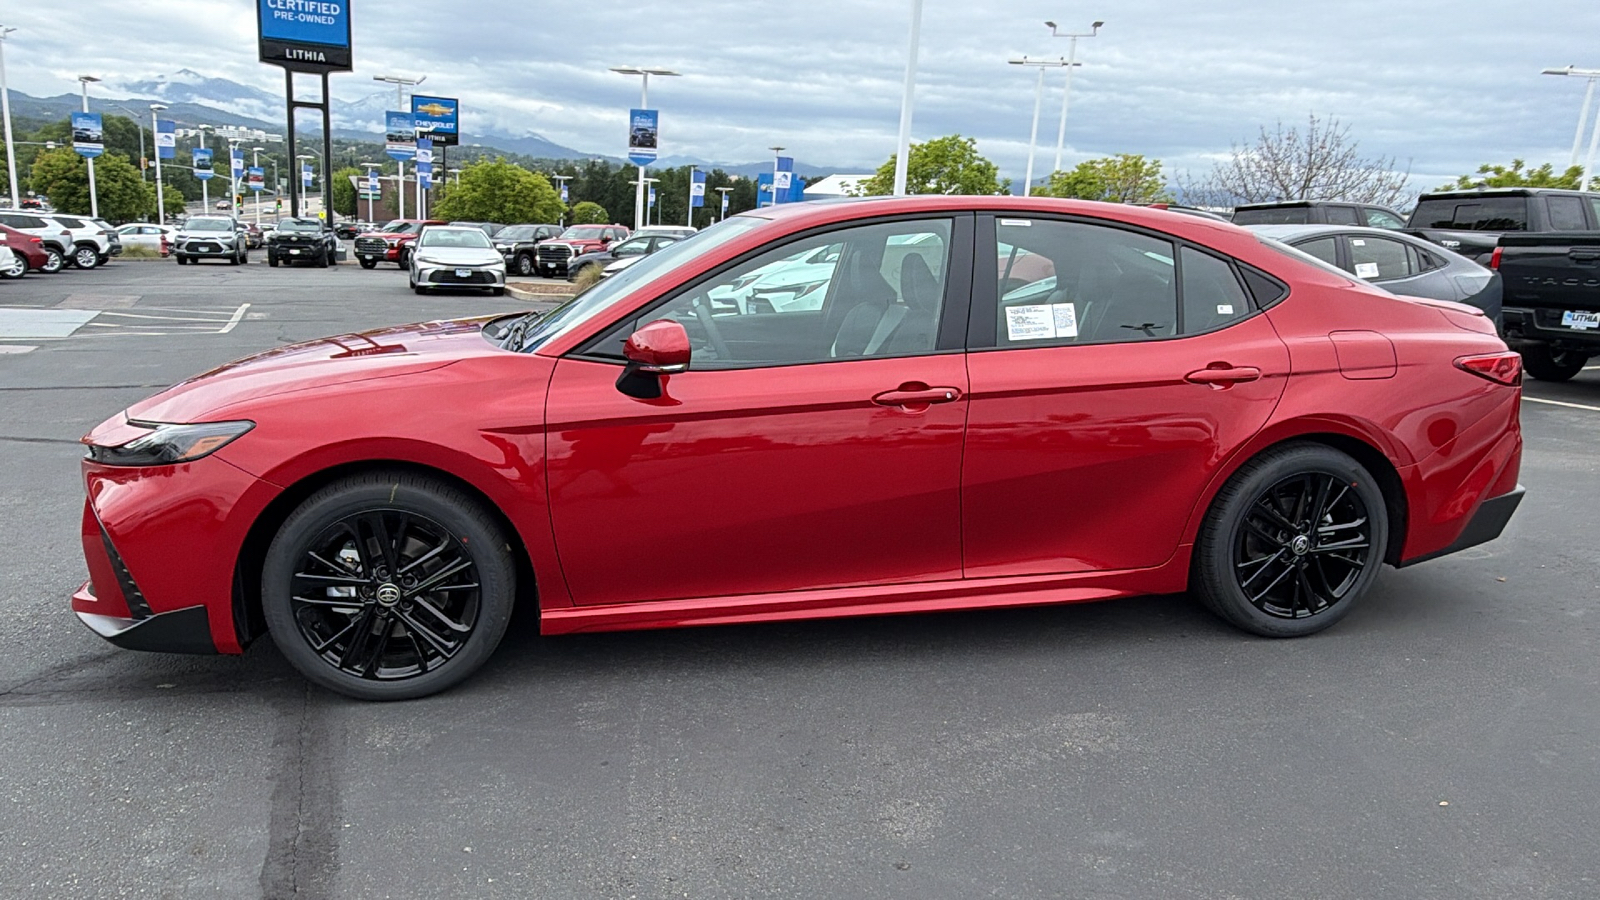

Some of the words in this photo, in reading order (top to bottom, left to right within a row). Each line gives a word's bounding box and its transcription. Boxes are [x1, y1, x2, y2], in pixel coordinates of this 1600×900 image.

[267, 0, 340, 15] CERTIFIED
[274, 11, 335, 25] PRE-OWNED
[285, 48, 326, 62] LITHIA
[415, 120, 455, 129] CHEVROLET
[1572, 314, 1598, 322] LITHIA
